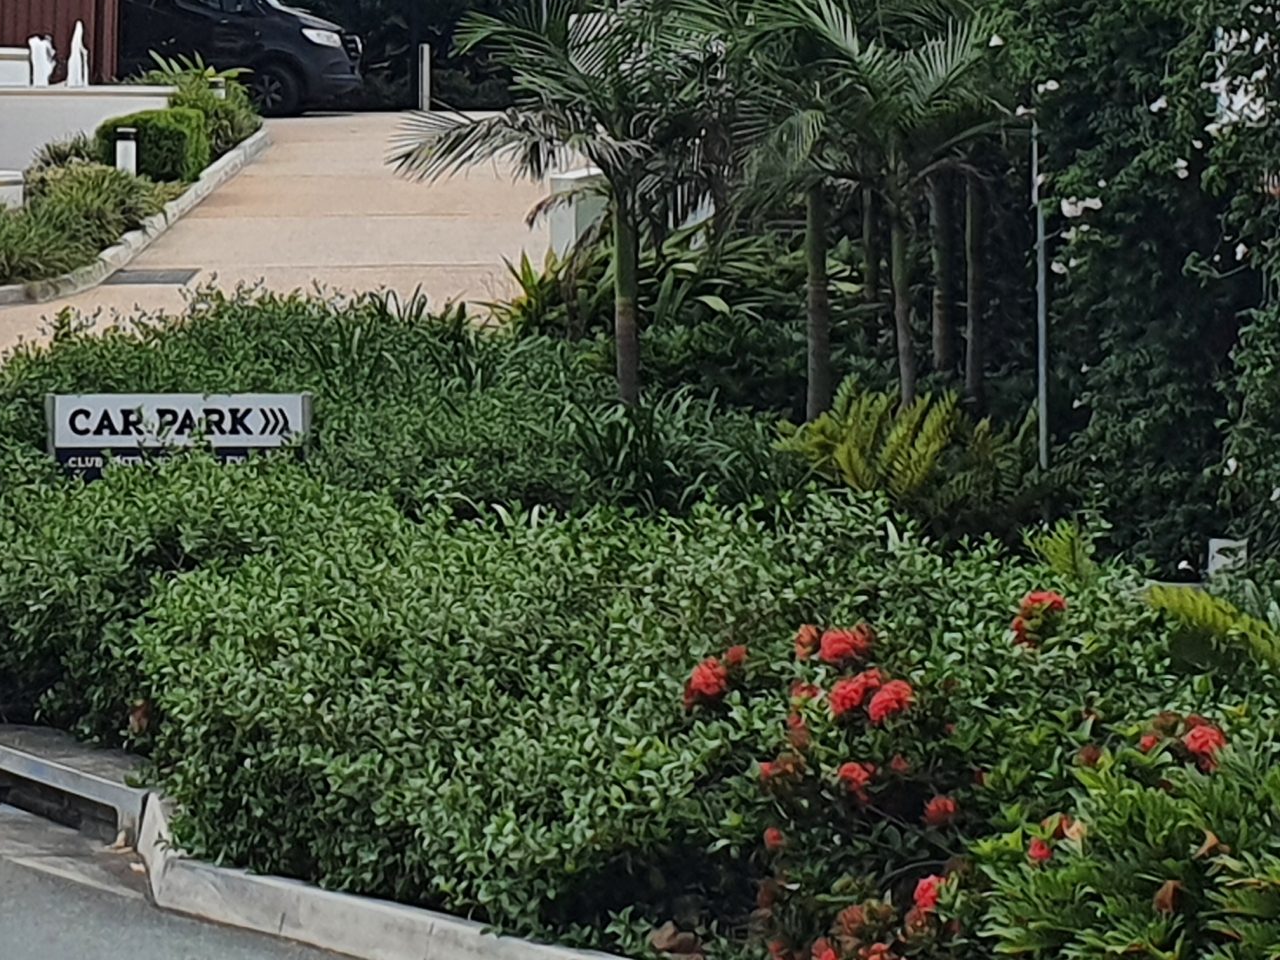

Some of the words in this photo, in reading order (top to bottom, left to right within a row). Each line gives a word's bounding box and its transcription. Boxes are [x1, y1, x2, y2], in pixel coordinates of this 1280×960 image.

[68, 408, 145, 436] CAR
[156, 408, 253, 436] PARK
[69, 456, 103, 468] CLUB
